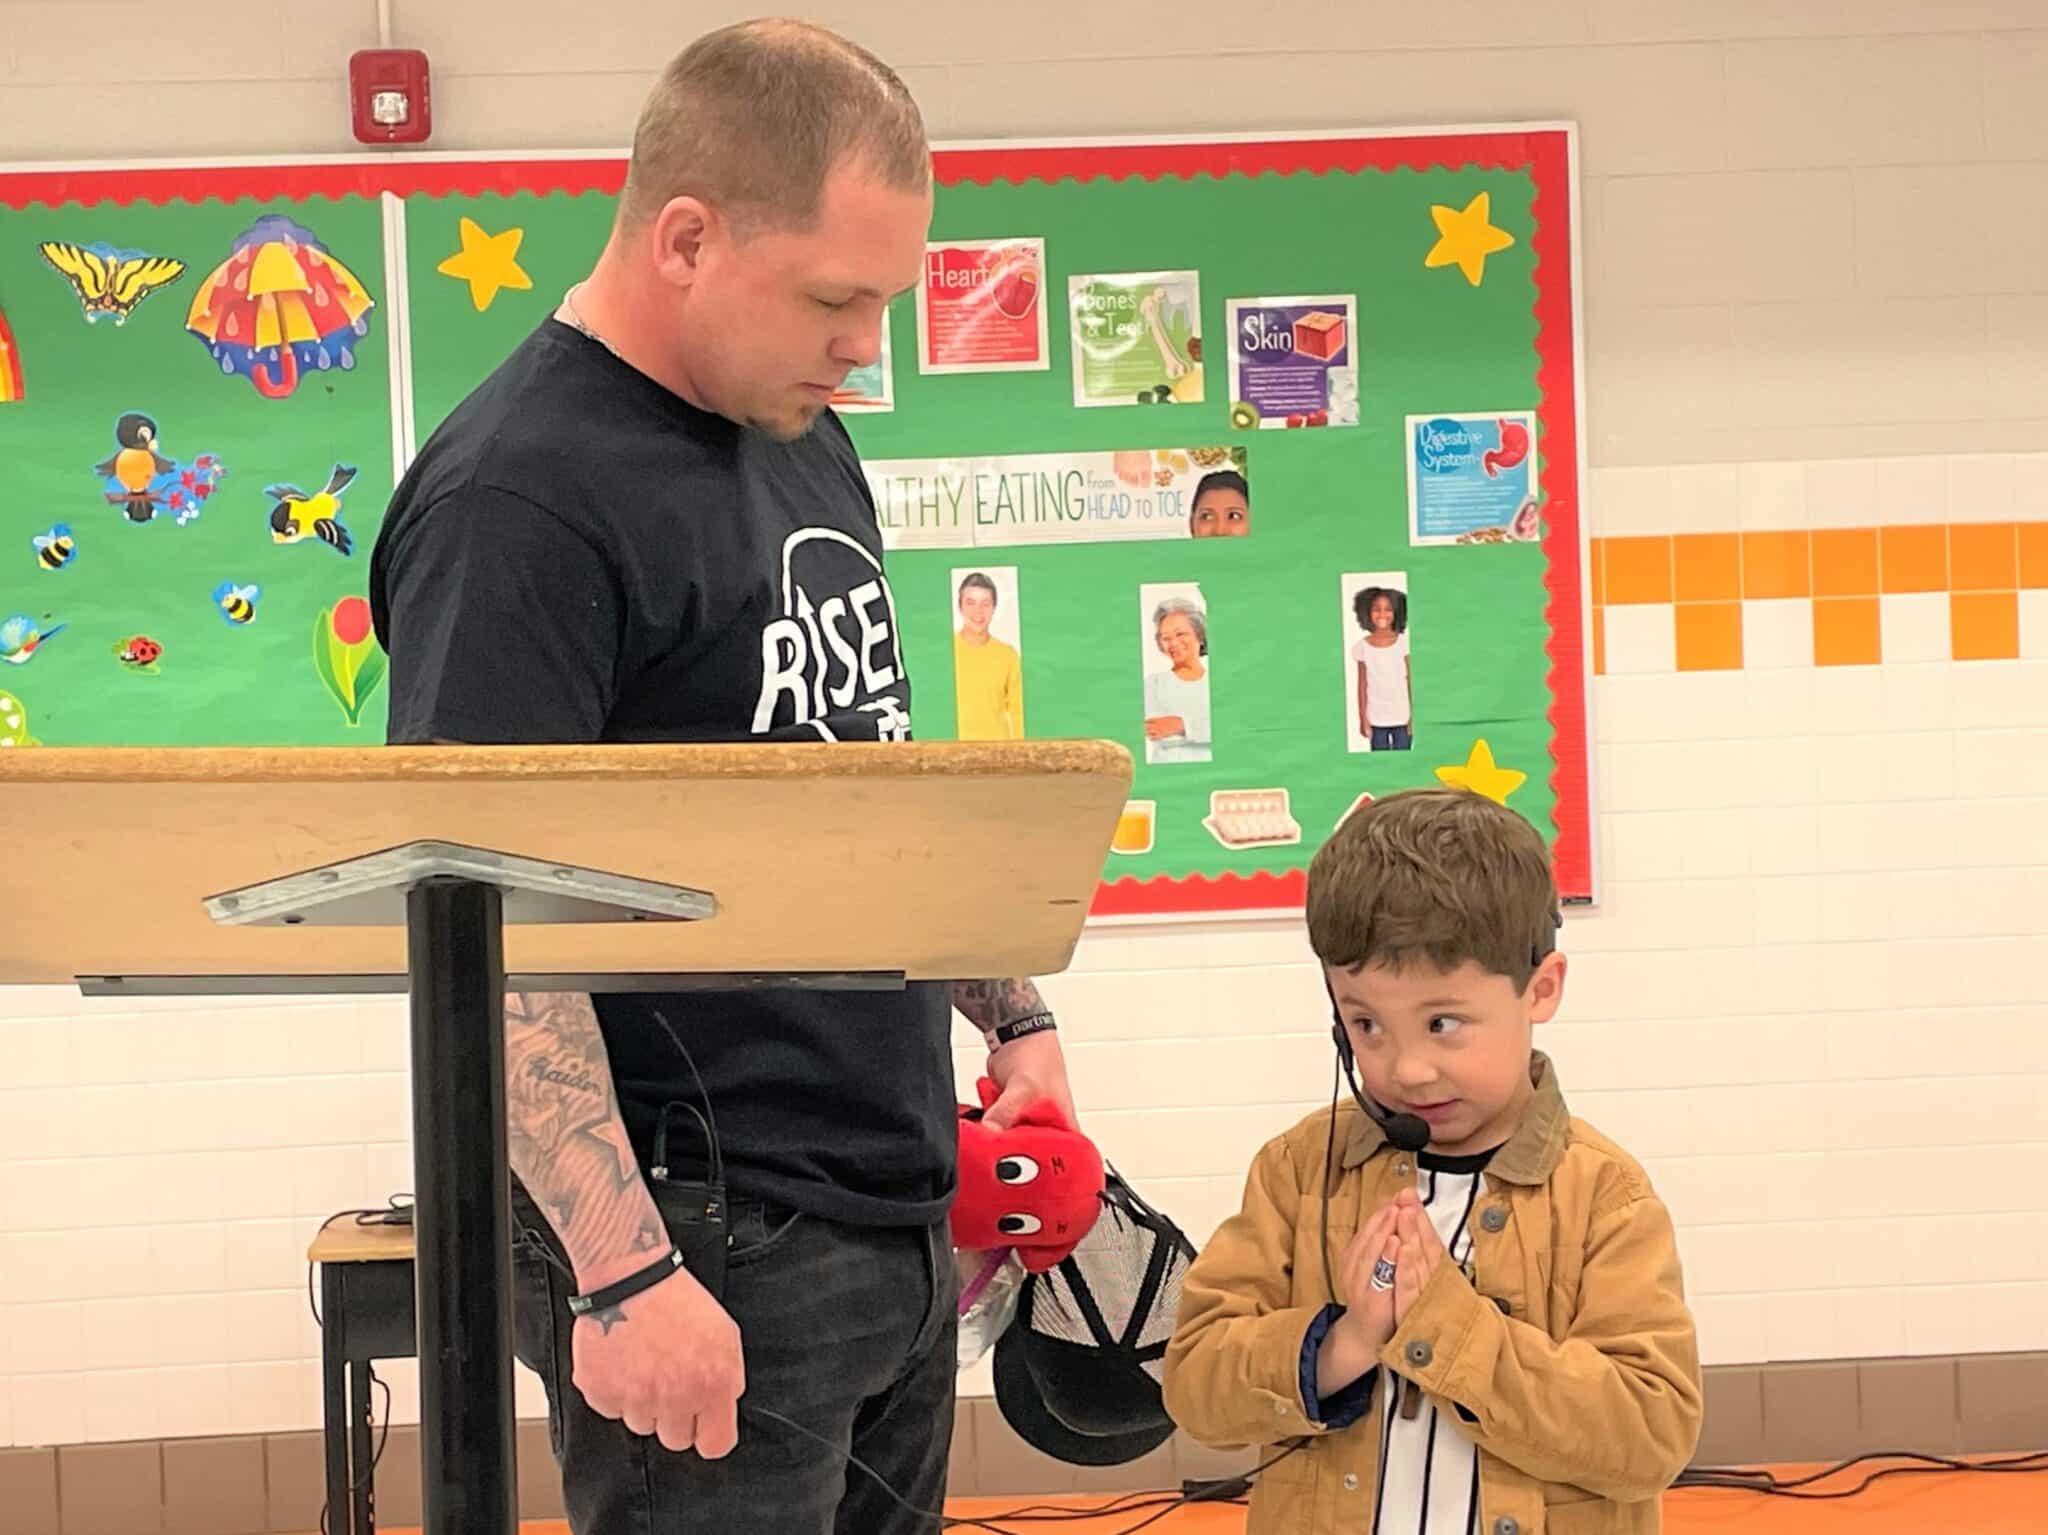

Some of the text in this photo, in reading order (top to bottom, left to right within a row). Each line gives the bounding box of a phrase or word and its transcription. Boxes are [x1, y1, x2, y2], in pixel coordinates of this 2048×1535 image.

[927, 253, 991, 289] Heart
[1244, 312, 1293, 352] Skin
[1423, 445, 1477, 473] System
[1087, 470, 1115, 489] from
[974, 470, 1085, 526] EATING
[1087, 493, 1131, 520] HEAD
[1156, 490, 1185, 518] TOE
